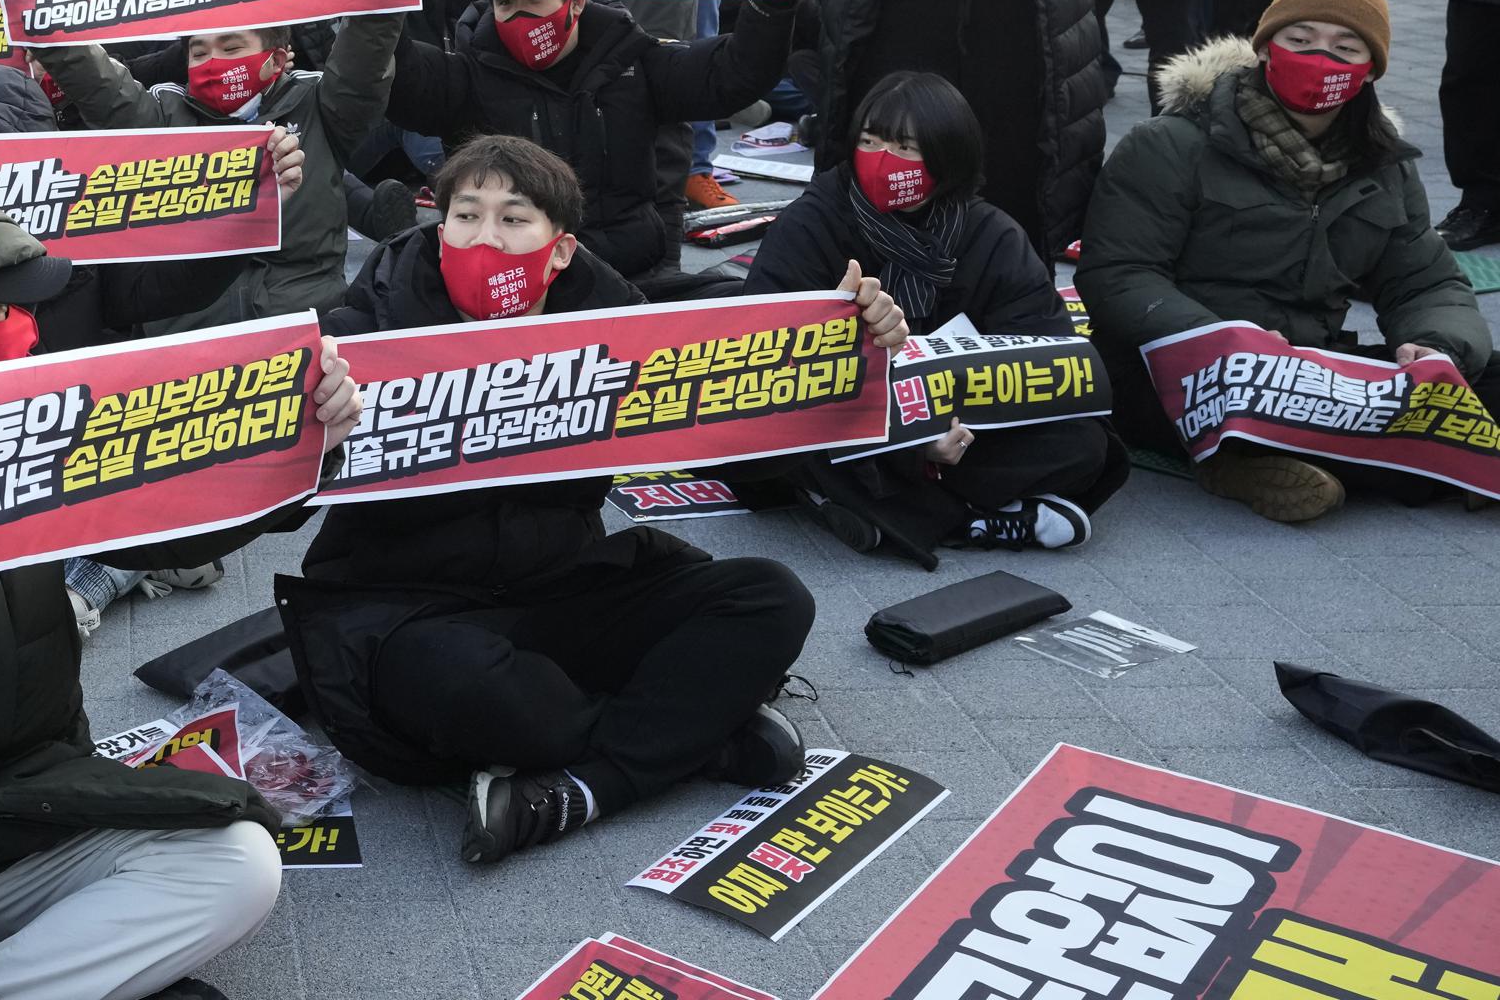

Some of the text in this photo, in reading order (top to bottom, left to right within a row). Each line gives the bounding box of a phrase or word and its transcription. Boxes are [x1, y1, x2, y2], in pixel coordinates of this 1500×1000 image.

[86, 146, 260, 195] 손실보상 0원
[66, 180, 253, 230] 손실 보상하라!
[488, 267, 526, 286] 매출규모
[491, 278, 527, 299] 상관없이
[501, 293, 520, 308] 손실
[637, 331, 790, 386] 손실보상
[793, 316, 855, 360] 0원
[87, 364, 236, 438] 손실보상
[235, 348, 303, 401] 0원
[963, 356, 1094, 407] 보이는가!
[1181, 356, 1224, 409] 1년
[1224, 352, 1408, 408] 8개월동안
[461, 357, 857, 457] 상관없이 손실 보상하라!
[1254, 390, 1395, 434] 자영업자도
[63, 433, 142, 491] 손실
[143, 395, 301, 470] 보상하라!
[708, 764, 911, 914] 어찌 빚만 보이는가!
